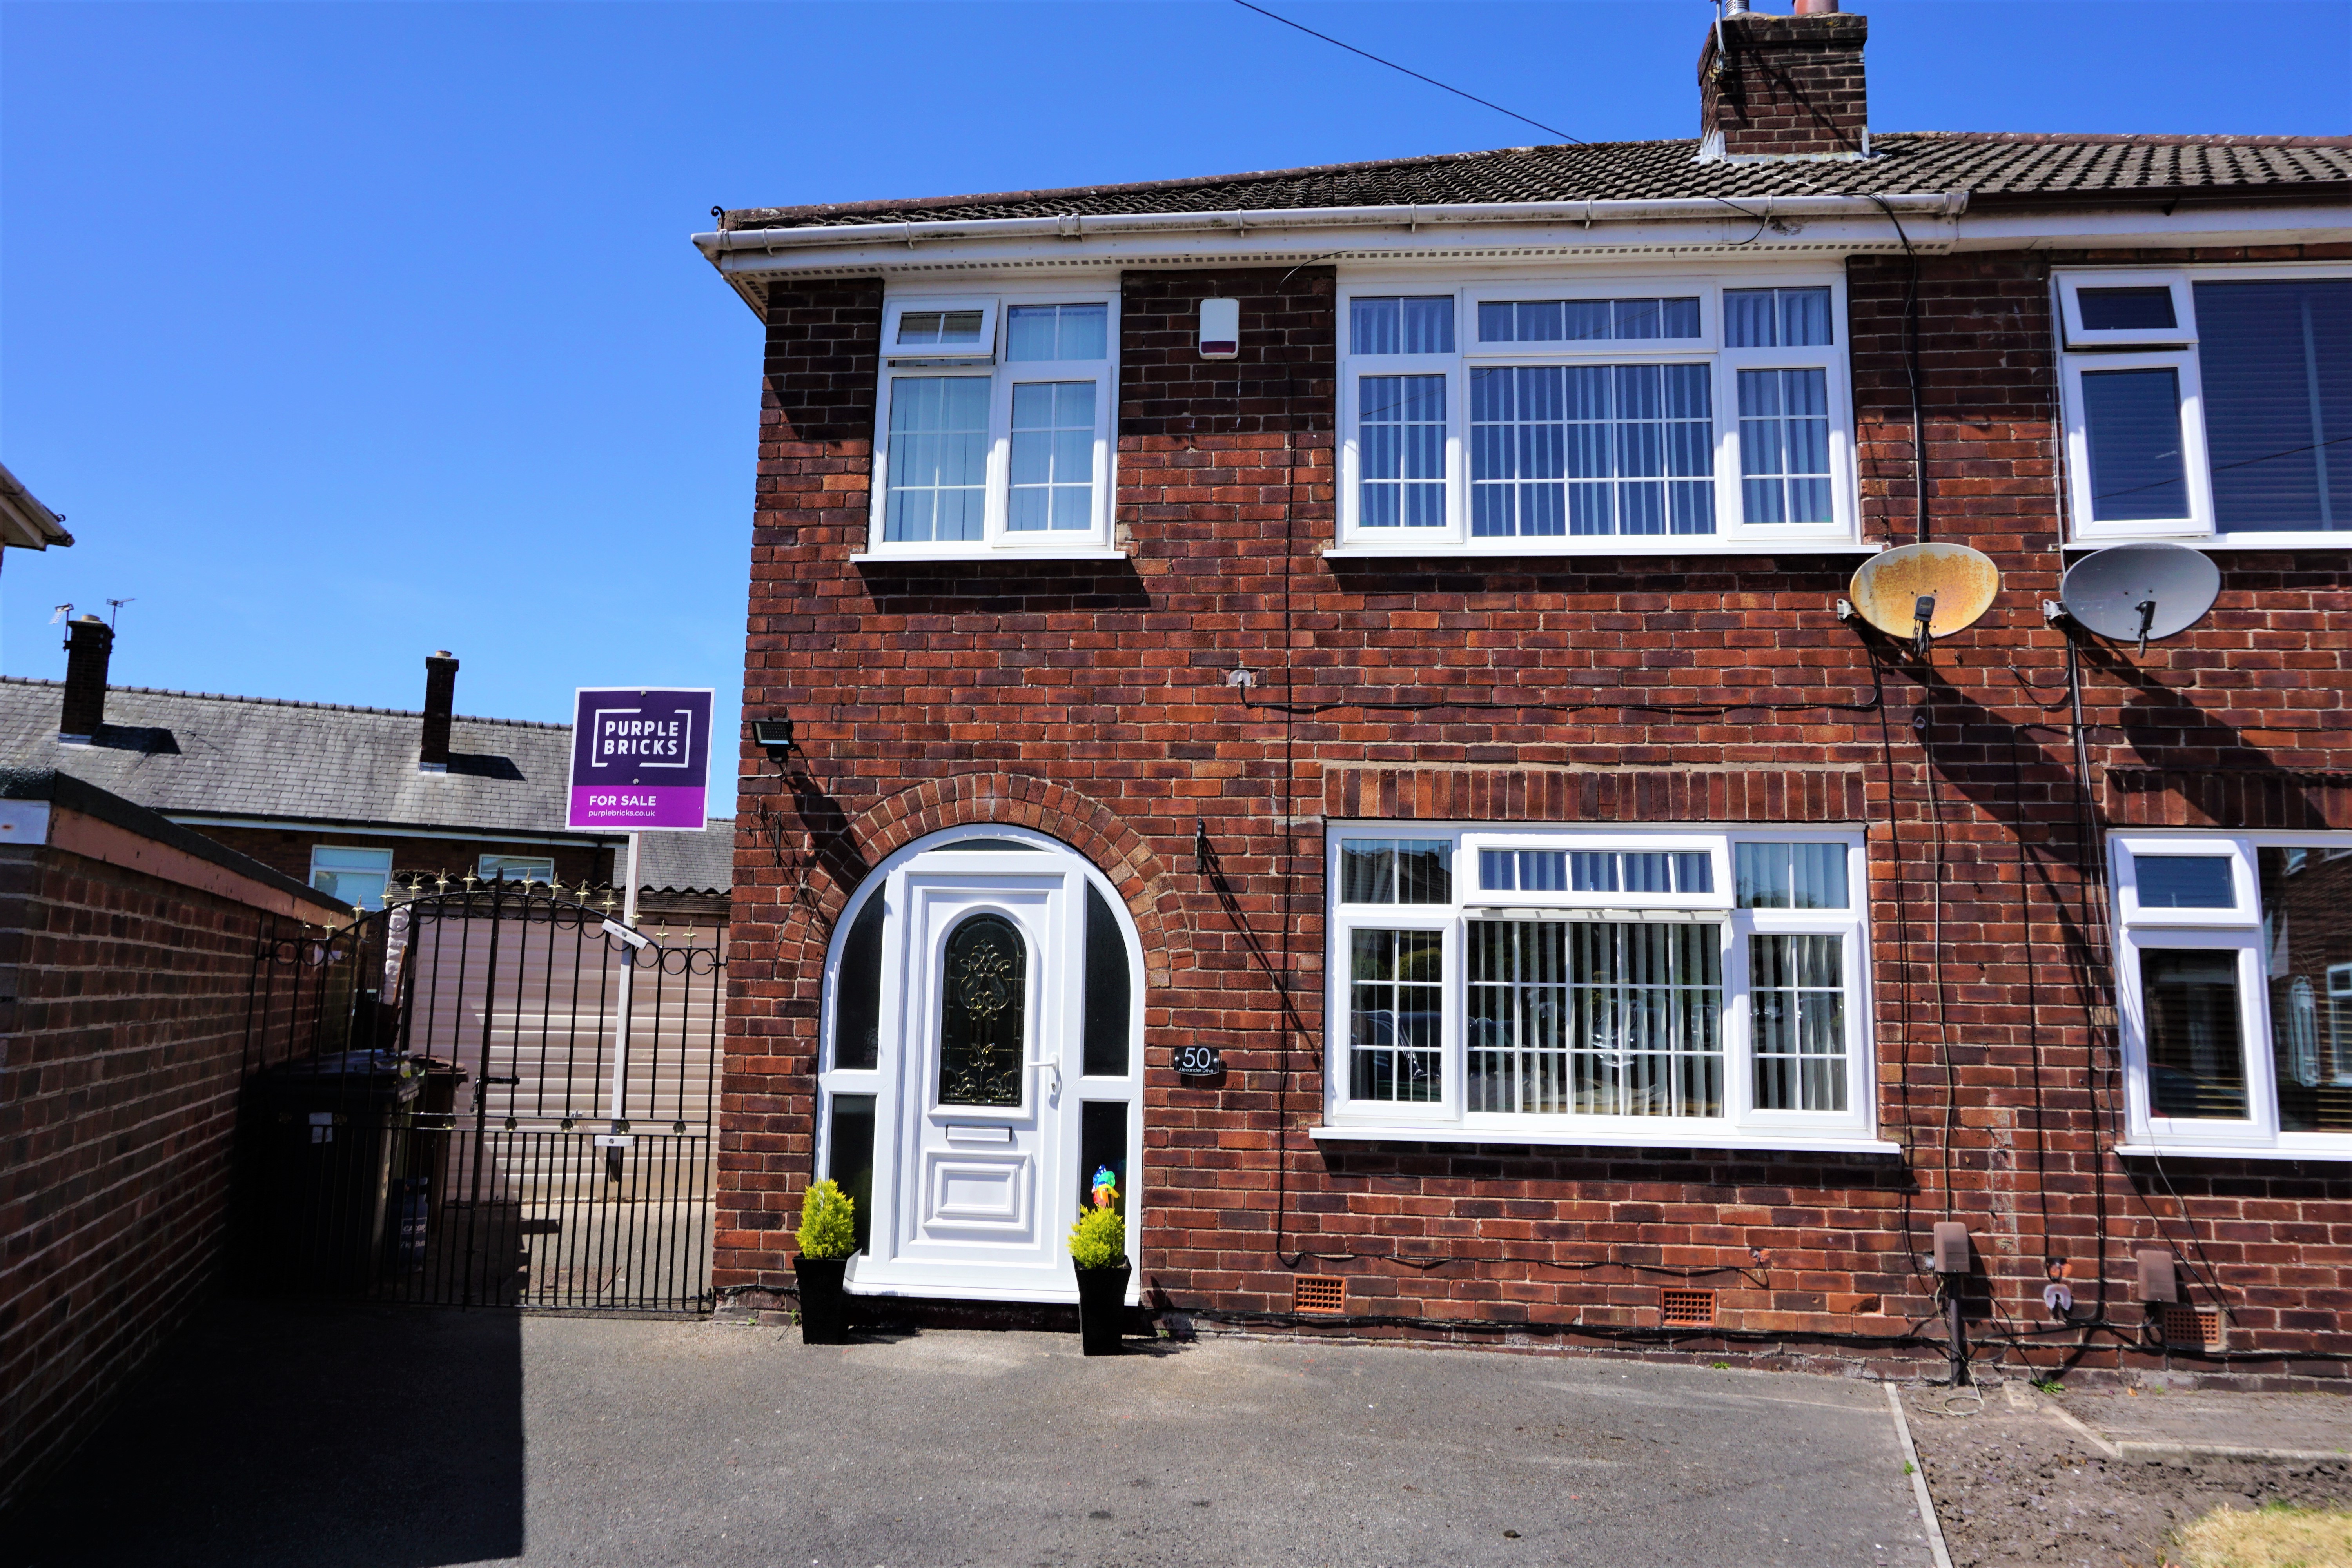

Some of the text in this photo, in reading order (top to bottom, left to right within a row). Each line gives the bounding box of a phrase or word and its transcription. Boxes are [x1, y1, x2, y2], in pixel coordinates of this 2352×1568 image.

[605, 721, 679, 736] PURPLE
[604, 739, 677, 755] BRICKS
[590, 795, 656, 806] FOR SALE
[1182, 1047, 1210, 1068] 50
